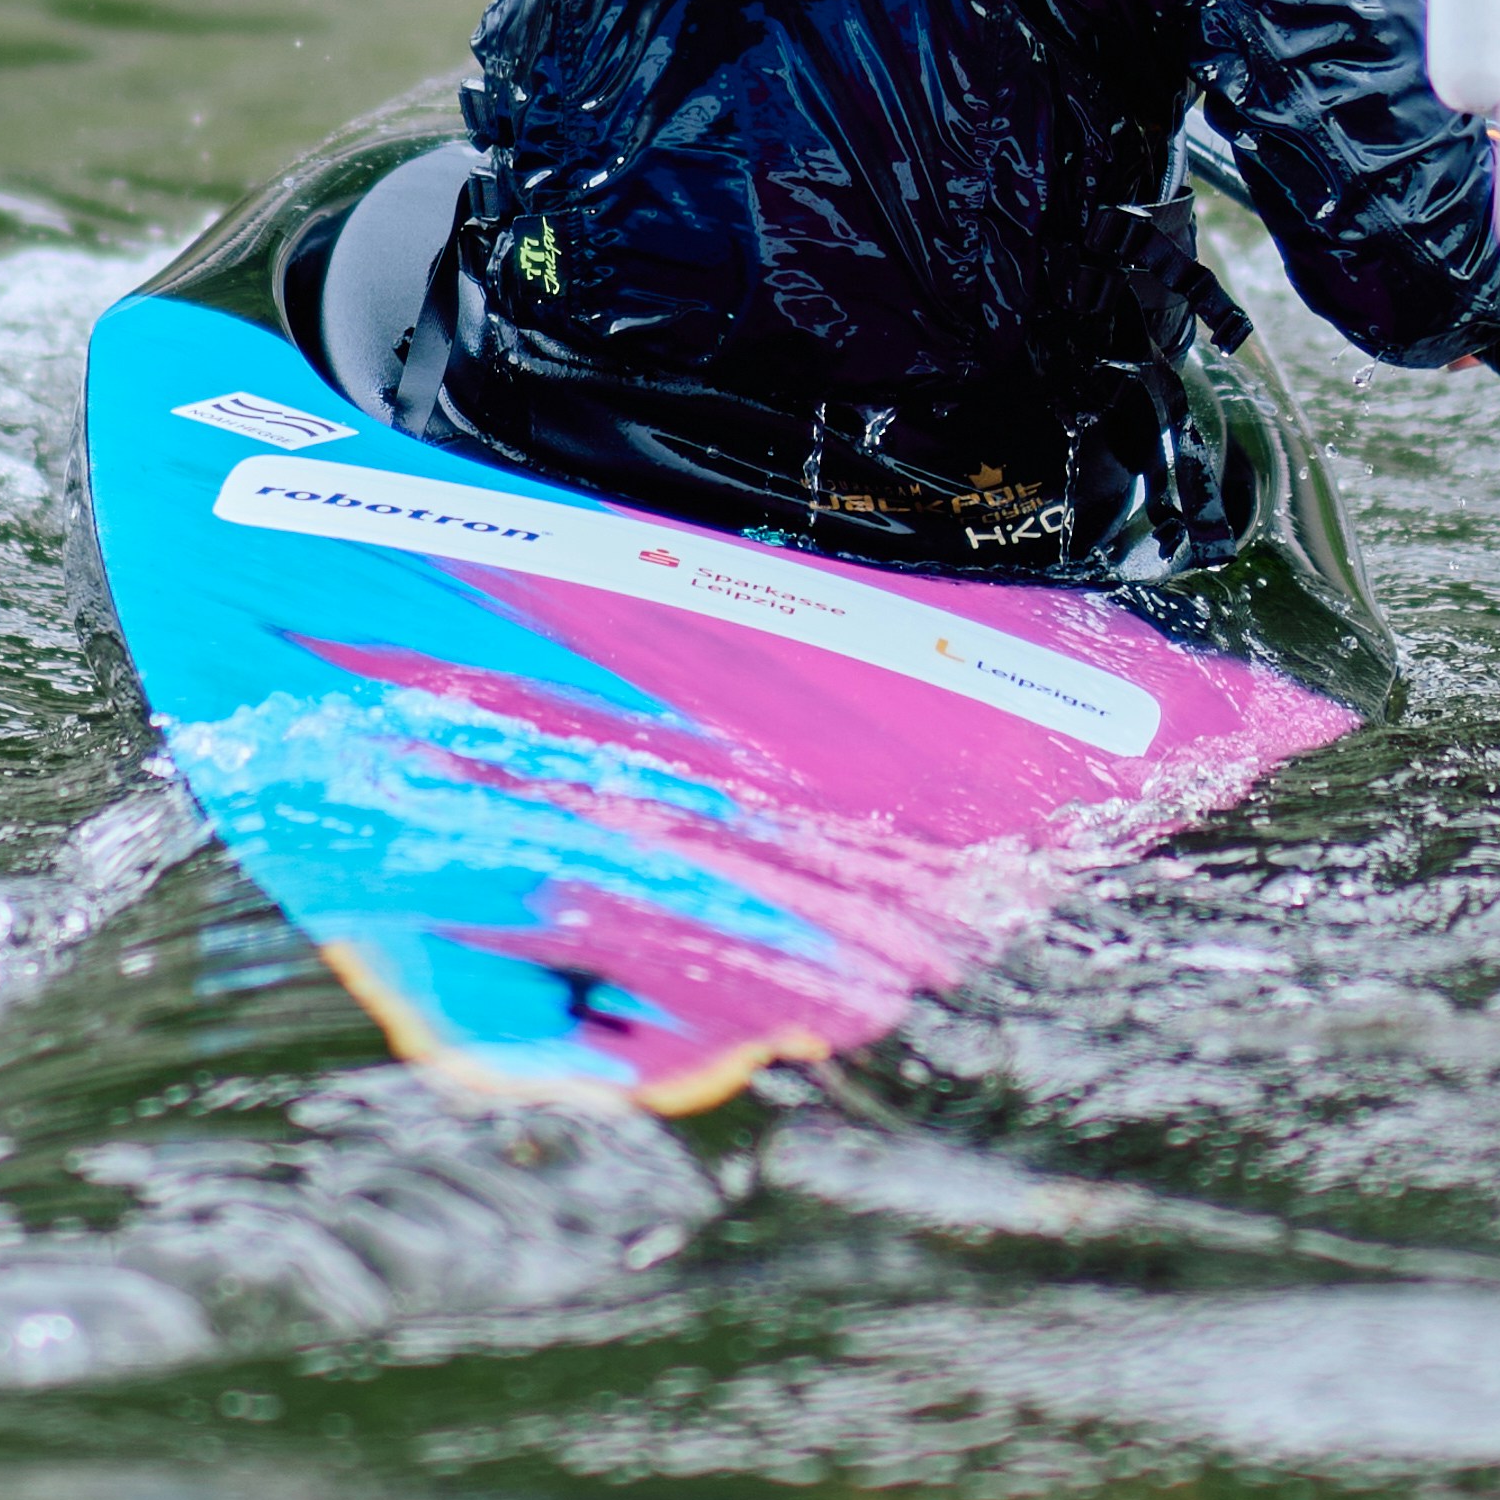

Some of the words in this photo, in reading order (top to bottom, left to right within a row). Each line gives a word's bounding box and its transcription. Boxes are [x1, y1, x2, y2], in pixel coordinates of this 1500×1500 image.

[189, 409, 236, 427] NOAH
[237, 423, 295, 445] HEGGE
[255, 485, 541, 543] robotron
[691, 578, 796, 615] Leipzig
[694, 566, 847, 616] Sparkasse
[976, 660, 1112, 717] Leipziger
